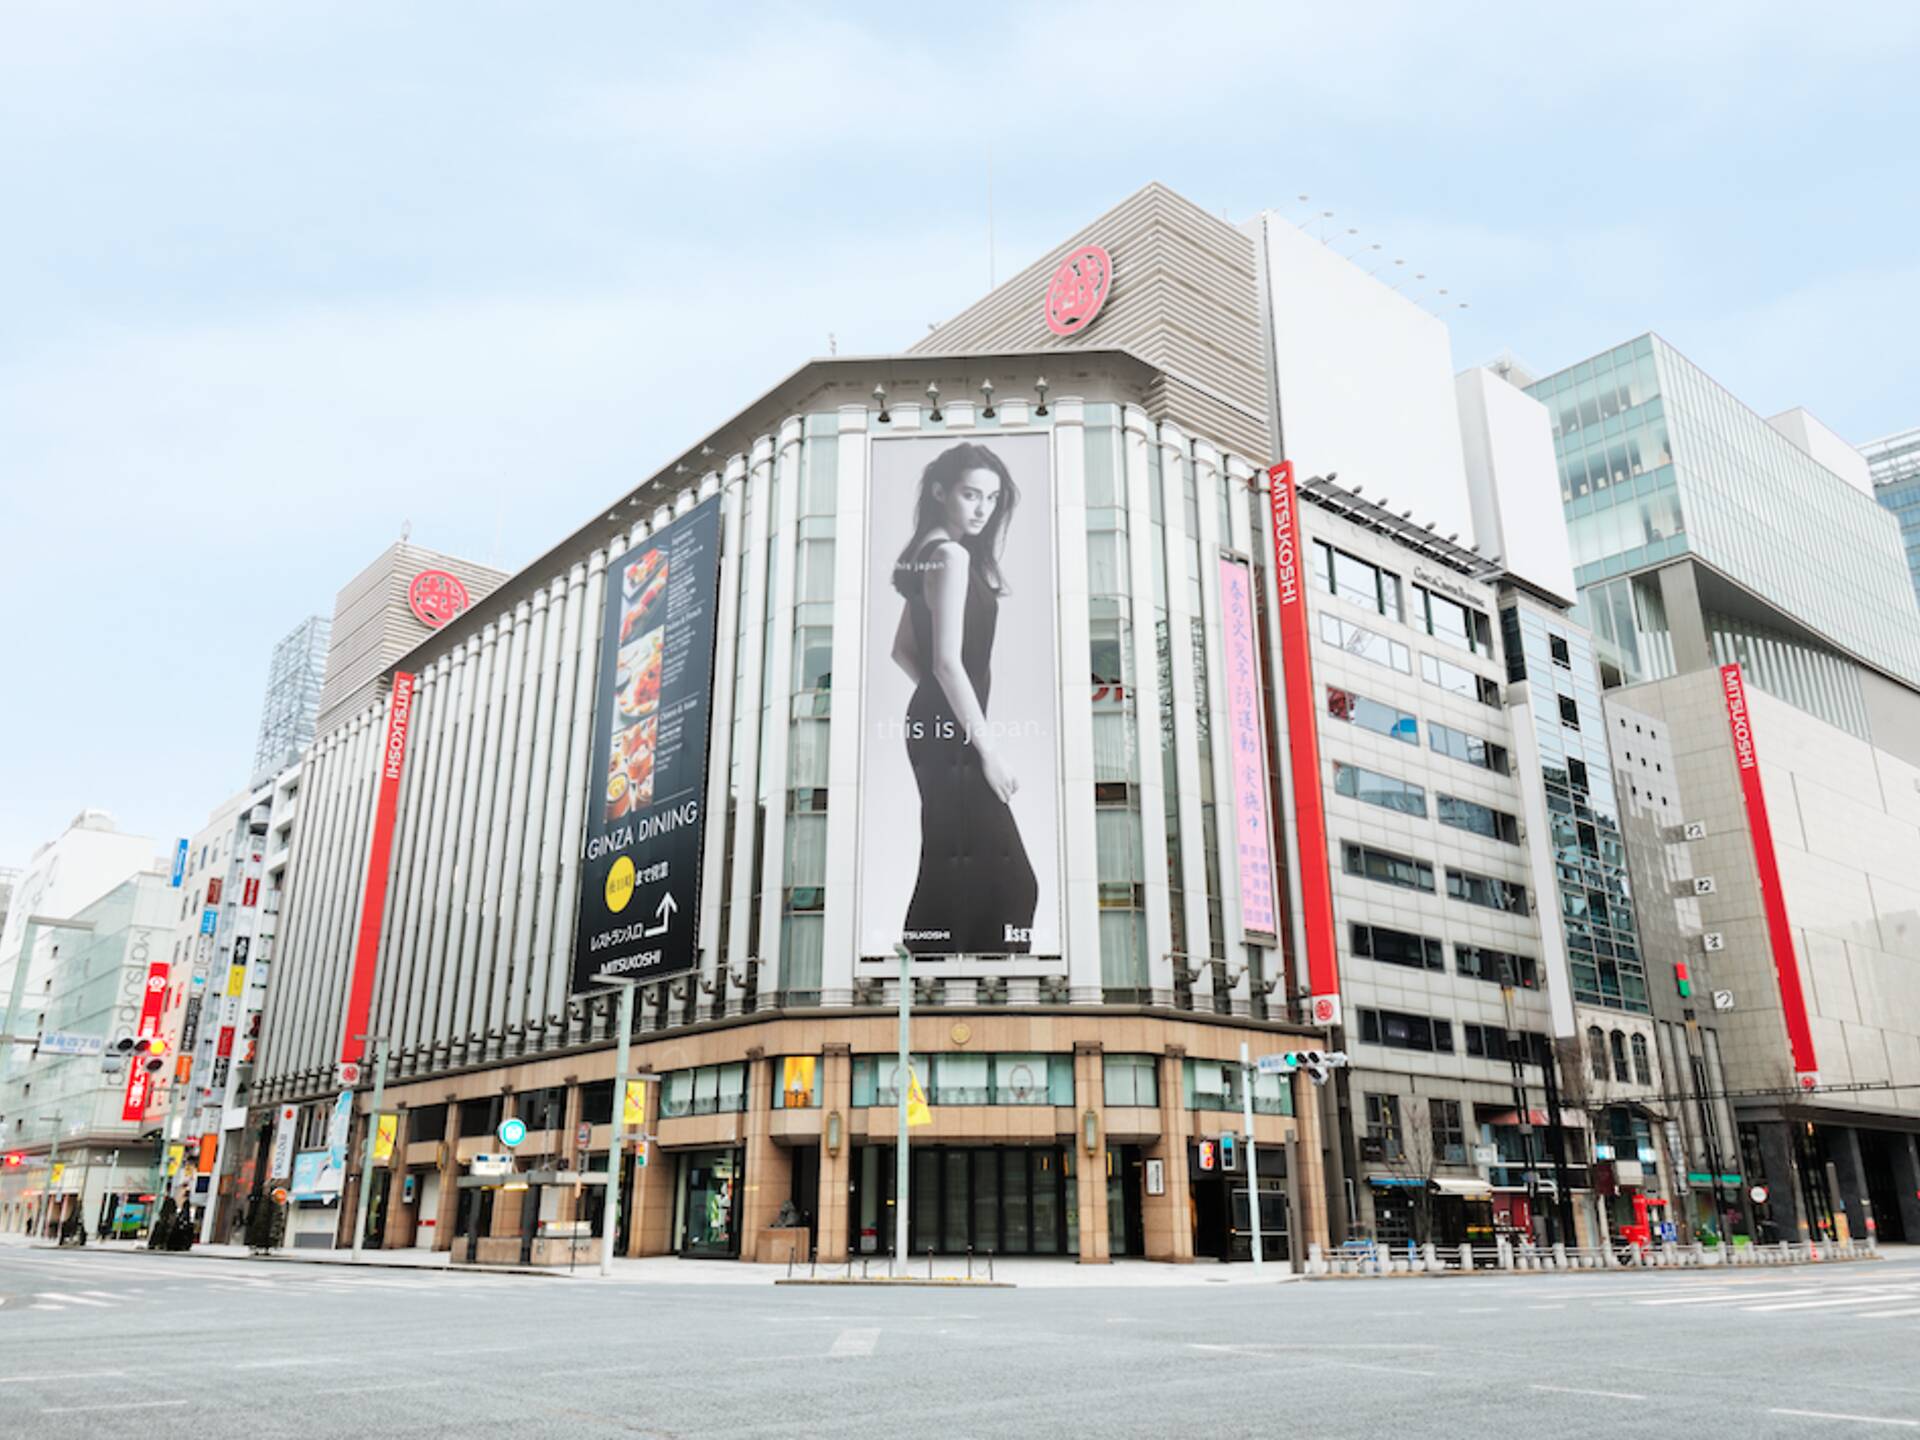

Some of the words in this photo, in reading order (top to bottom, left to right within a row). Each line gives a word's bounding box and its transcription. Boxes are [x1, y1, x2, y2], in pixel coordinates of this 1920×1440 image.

[1273, 471, 1297, 605] MITSUKOSHI
[386, 679, 411, 779] MITSUKOSHI
[876, 714, 924, 740] this
[935, 714, 955, 740] is
[1725, 671, 1755, 769] MITSUKOSHI
[587, 826, 634, 860] GINZA
[639, 801, 698, 842] DINING
[600, 949, 662, 976] MITSUKOSHI
